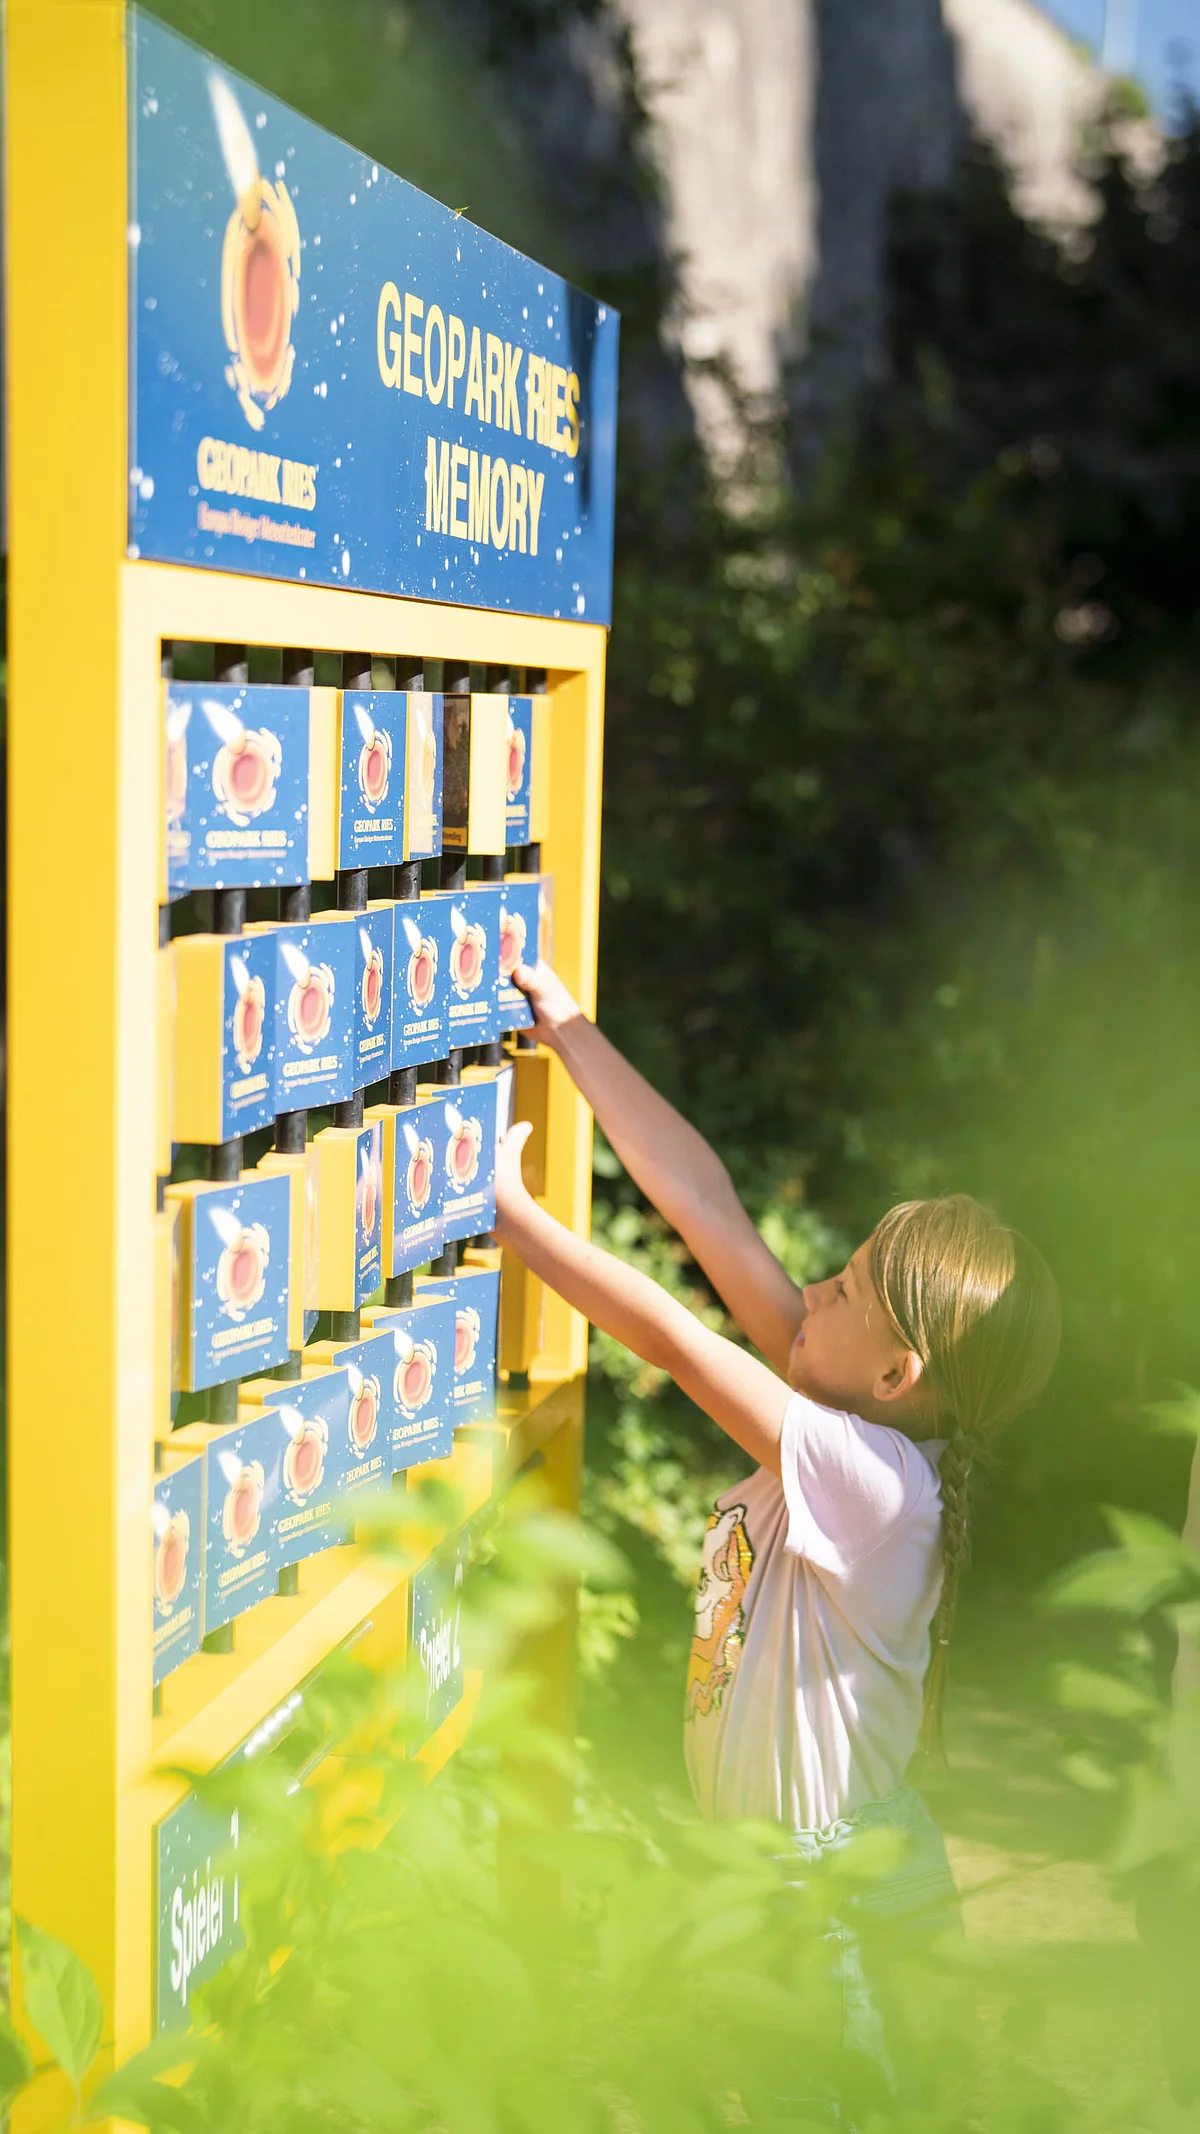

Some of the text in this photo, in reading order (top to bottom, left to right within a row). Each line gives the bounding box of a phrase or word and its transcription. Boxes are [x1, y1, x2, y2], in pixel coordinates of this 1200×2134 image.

[377, 281, 581, 459] GEOPARK RIES
[197, 436, 316, 511] GEOPARK RIES
[425, 436, 545, 557] MEMORY
[171, 1855, 225, 2008] Spieler
